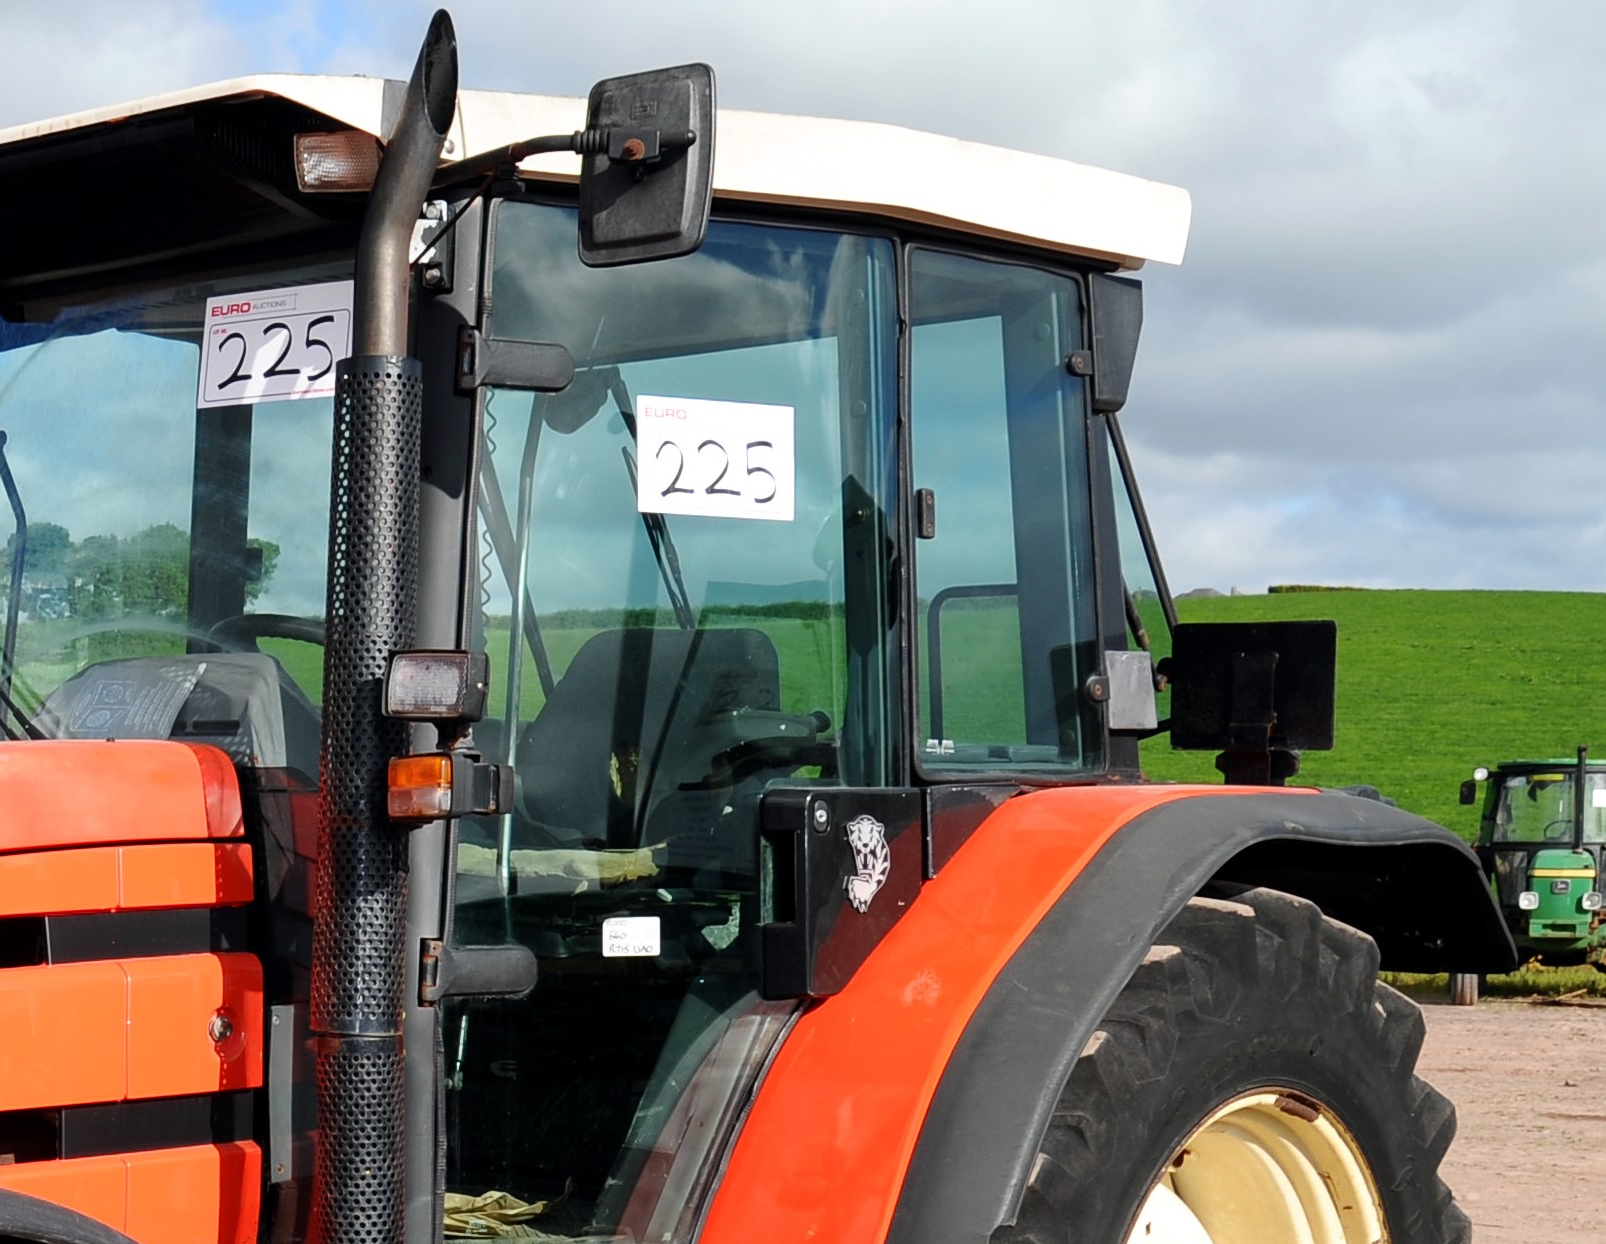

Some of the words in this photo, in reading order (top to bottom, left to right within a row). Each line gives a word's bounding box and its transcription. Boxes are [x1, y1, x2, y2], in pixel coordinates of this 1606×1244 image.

[211, 302, 251, 317] EURO
[217, 315, 335, 391] 225
[644, 406, 687, 420] EURO
[655, 439, 777, 504] 225
